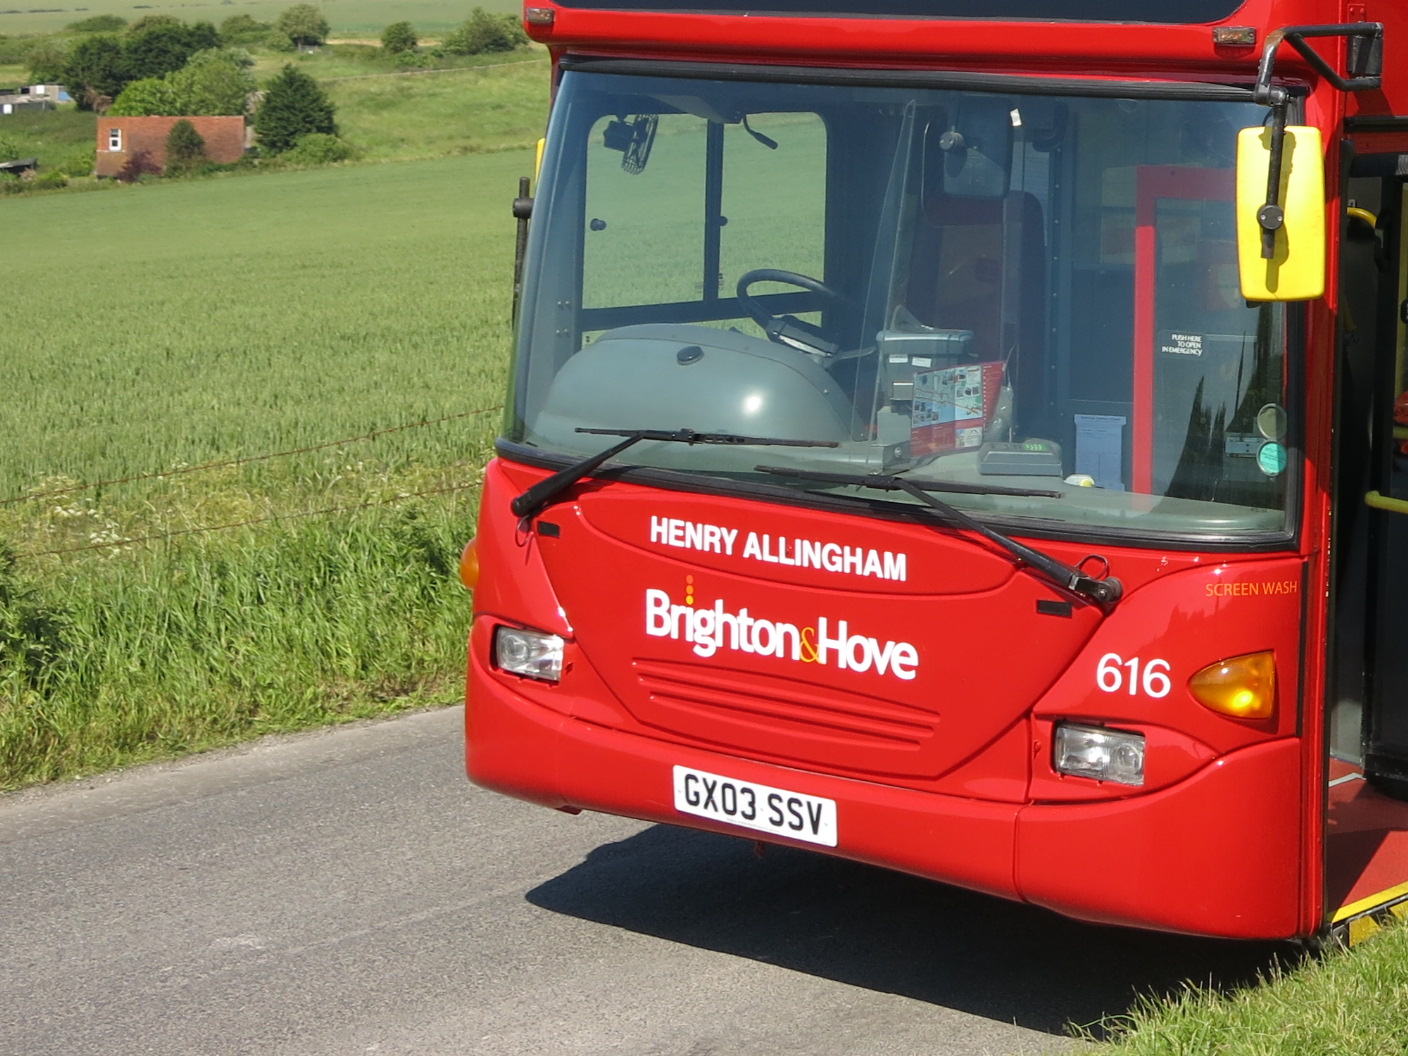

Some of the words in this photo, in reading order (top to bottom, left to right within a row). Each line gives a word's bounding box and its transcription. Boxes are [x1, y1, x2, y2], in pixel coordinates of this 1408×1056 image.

[1169, 346, 1202, 356] EMERGENCY
[650, 515, 738, 556] HENRY
[743, 532, 907, 582] ALLINGHAM
[1205, 582, 1259, 597] SCREEN
[1262, 580, 1298, 595] WASH
[1096, 652, 1172, 699] 616
[684, 773, 757, 821] GX03
[767, 793, 822, 836] SSV
